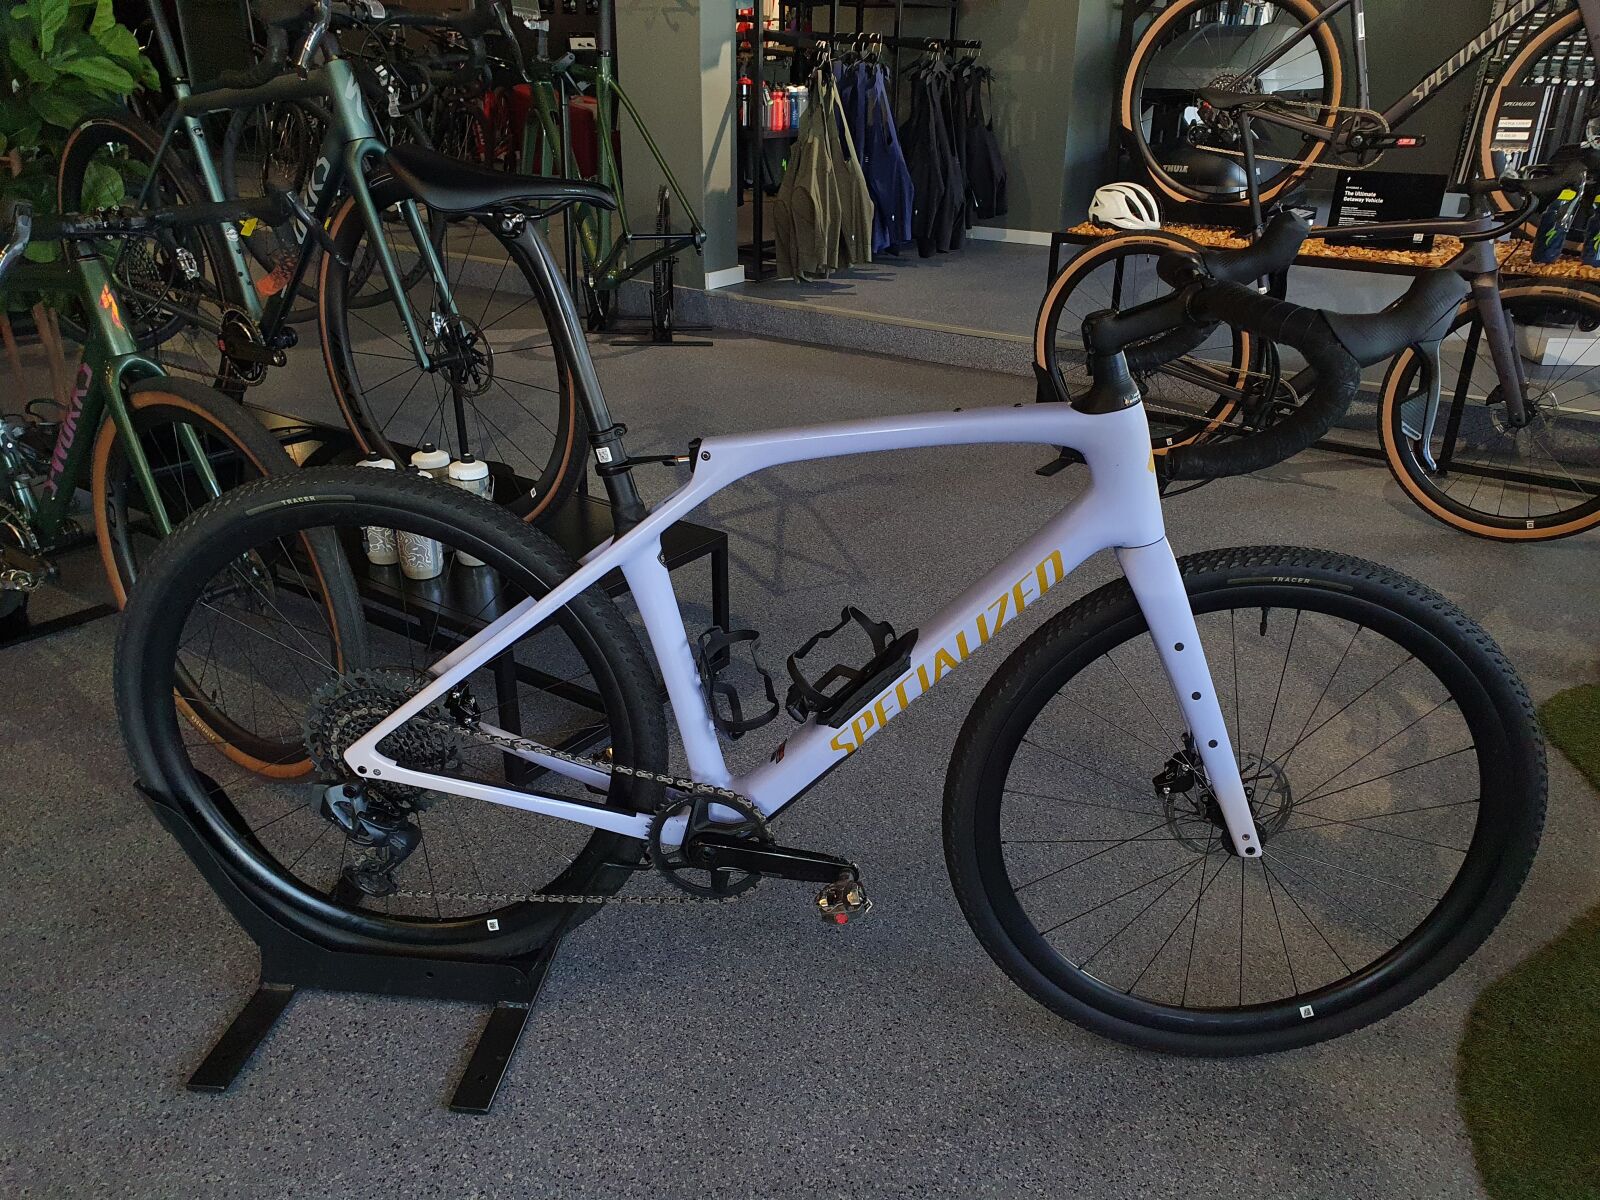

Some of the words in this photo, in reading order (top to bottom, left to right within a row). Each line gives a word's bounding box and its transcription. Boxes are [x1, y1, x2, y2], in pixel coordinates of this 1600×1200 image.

[1411, 0, 1536, 105] SPECIALIZED
[1162, 164, 1189, 173] THULE
[280, 495, 316, 506] TRACER
[1271, 576, 1311, 584] TRACER
[829, 549, 1065, 755] SPECIALIZED
